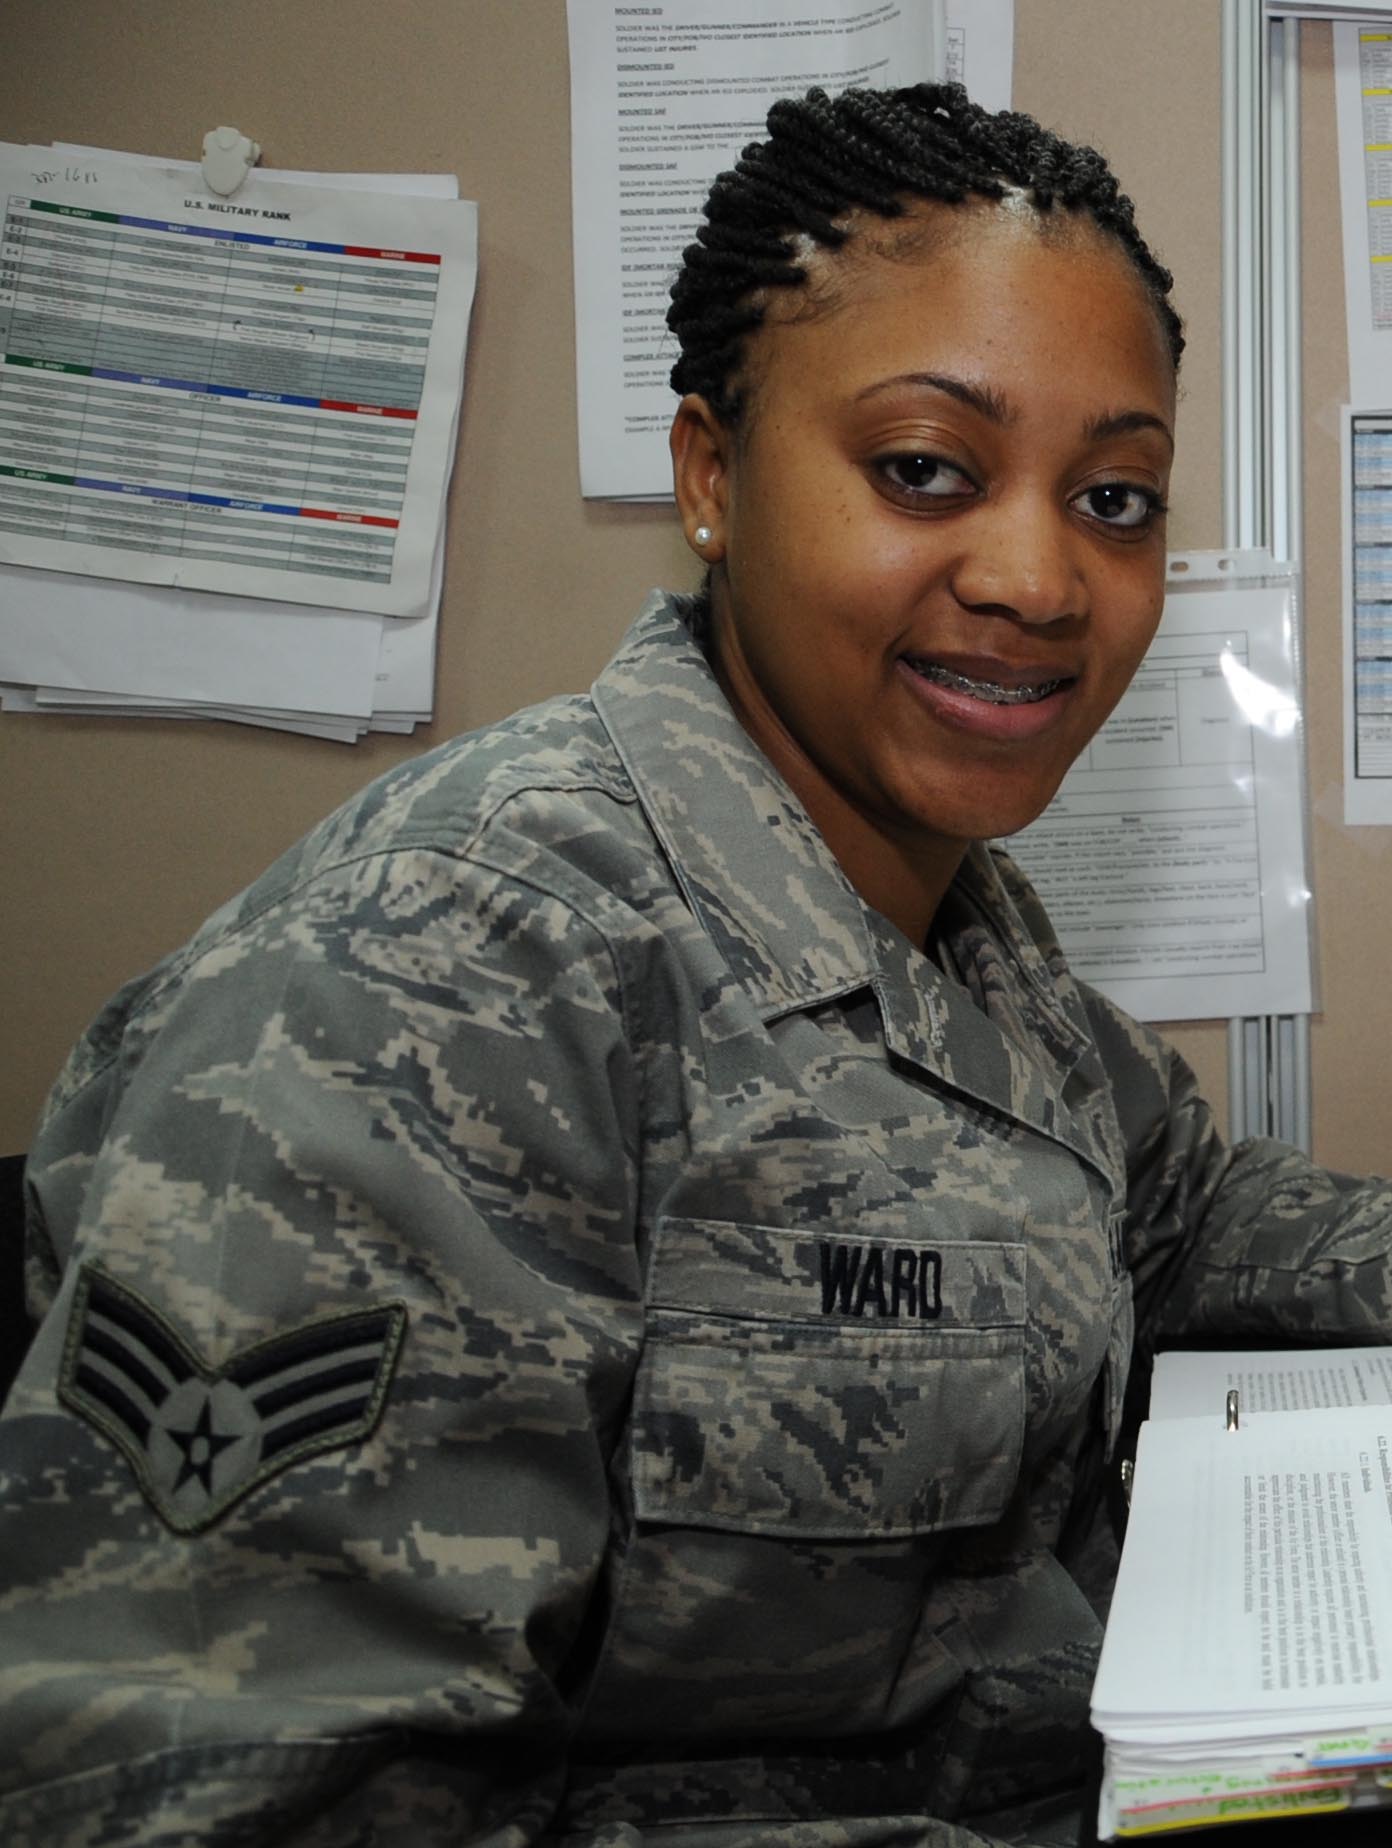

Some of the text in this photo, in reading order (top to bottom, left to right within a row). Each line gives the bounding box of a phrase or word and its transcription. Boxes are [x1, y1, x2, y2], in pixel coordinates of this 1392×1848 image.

[184, 200, 291, 222] U.S. MILITARY RANK
[820, 1242, 942, 1319] WARD
